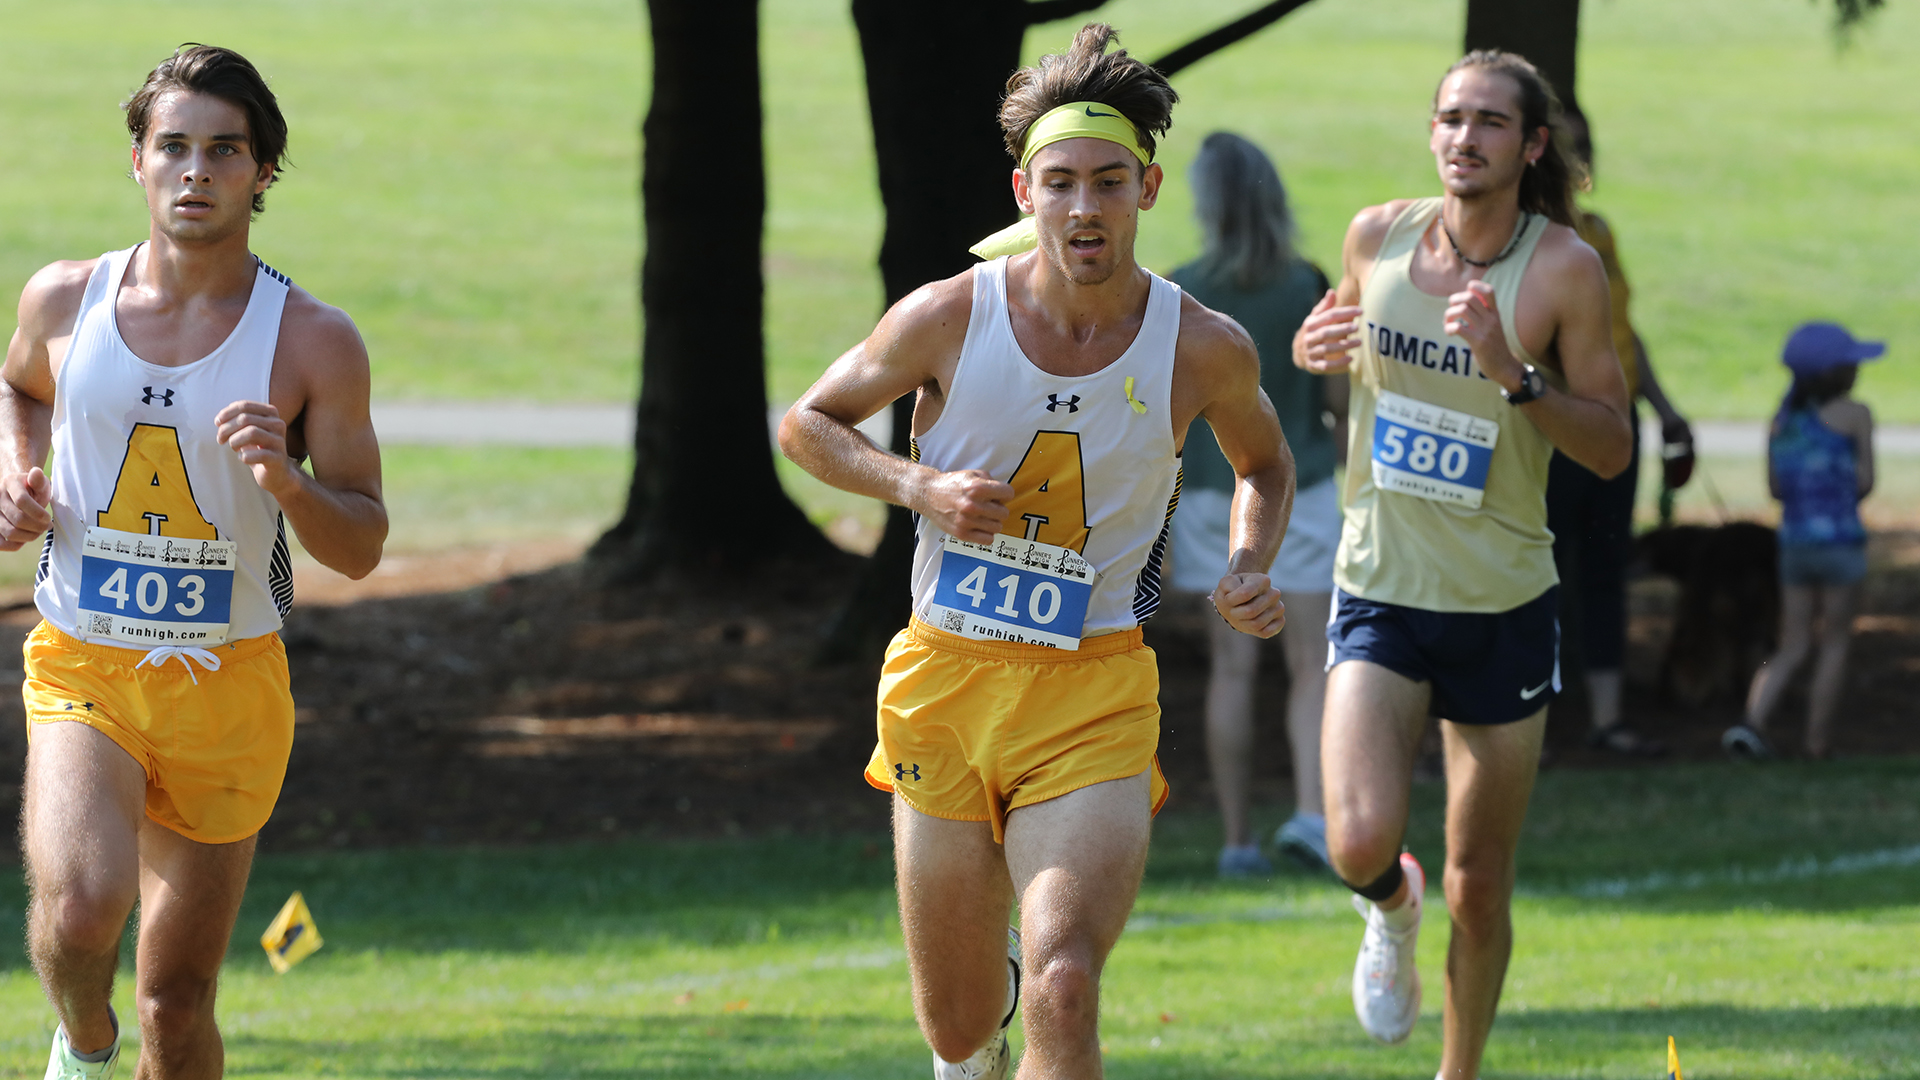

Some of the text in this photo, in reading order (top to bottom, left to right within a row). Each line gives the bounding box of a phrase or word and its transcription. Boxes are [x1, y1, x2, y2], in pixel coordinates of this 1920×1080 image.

[1368, 323, 1488, 380] OMCAT
[1379, 425, 1469, 480] 580
[99, 567, 206, 616] 403
[956, 565, 1062, 625] 410
[121, 625, 206, 640] runhigh.com
